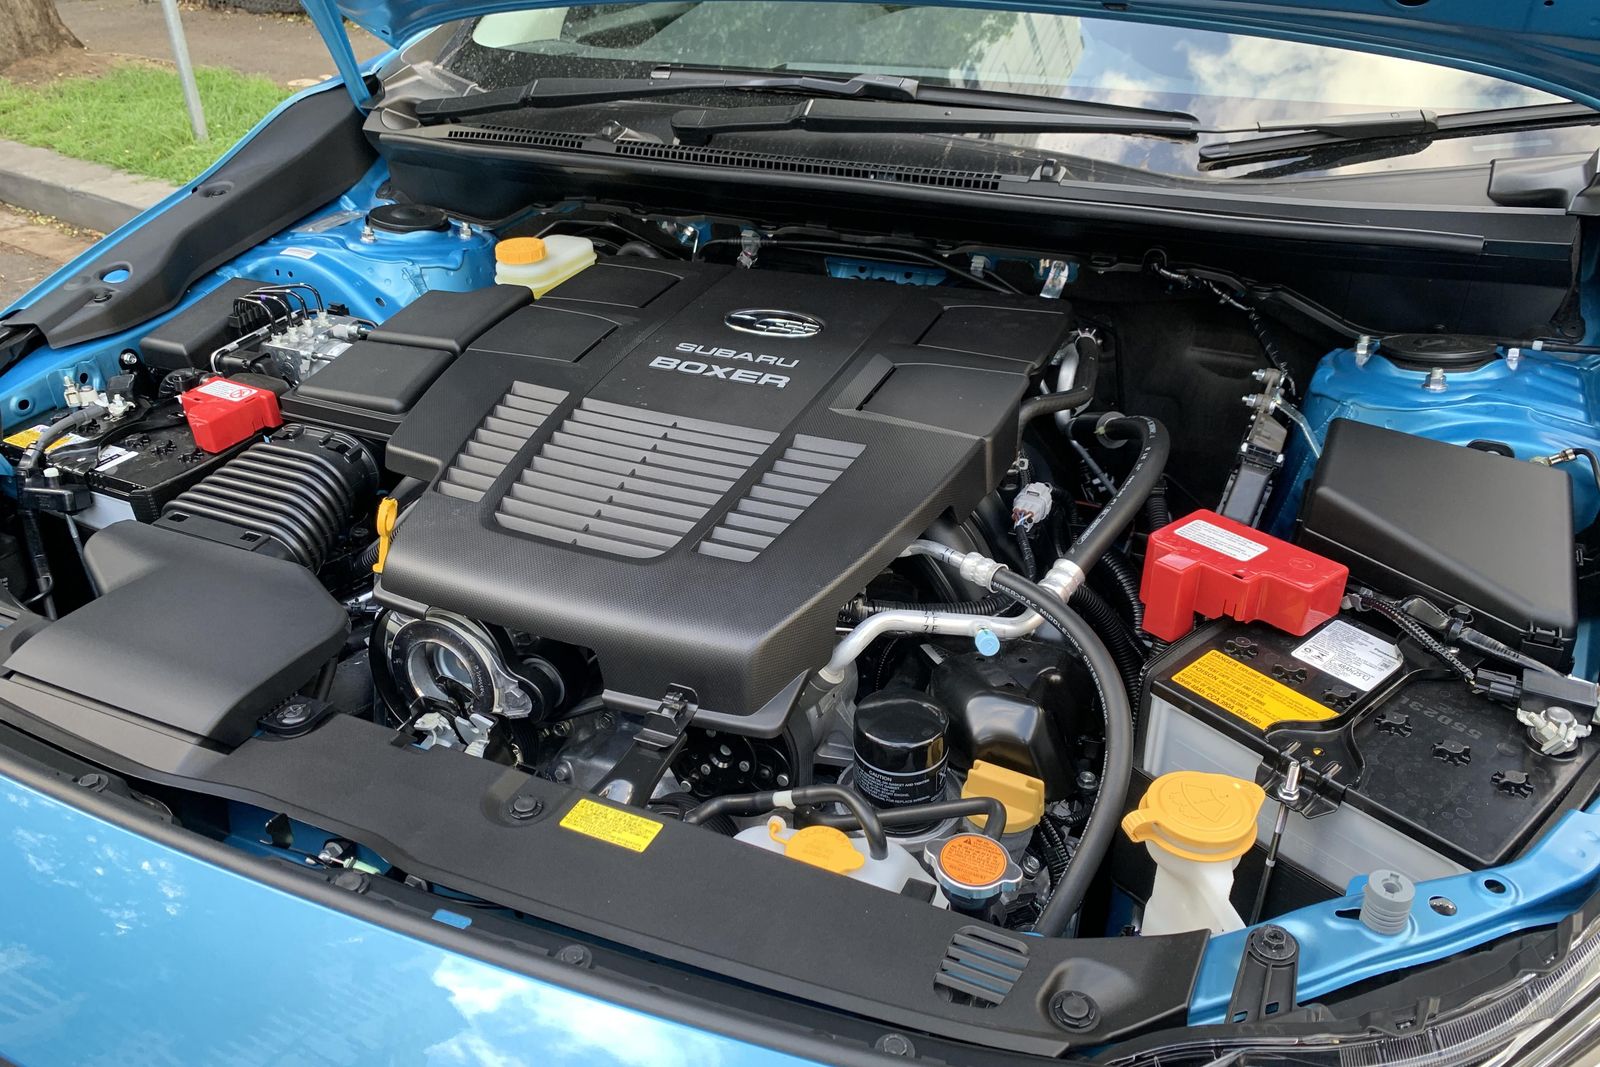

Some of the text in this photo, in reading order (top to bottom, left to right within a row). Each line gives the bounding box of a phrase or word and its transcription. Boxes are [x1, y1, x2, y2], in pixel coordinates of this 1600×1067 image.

[676, 342, 800, 368] SUBARU
[649, 356, 791, 388] BOXER
[1210, 652, 1239, 667] DANGER
[1192, 665, 1219, 681] POISON
[868, 770, 893, 782] CAUTION
